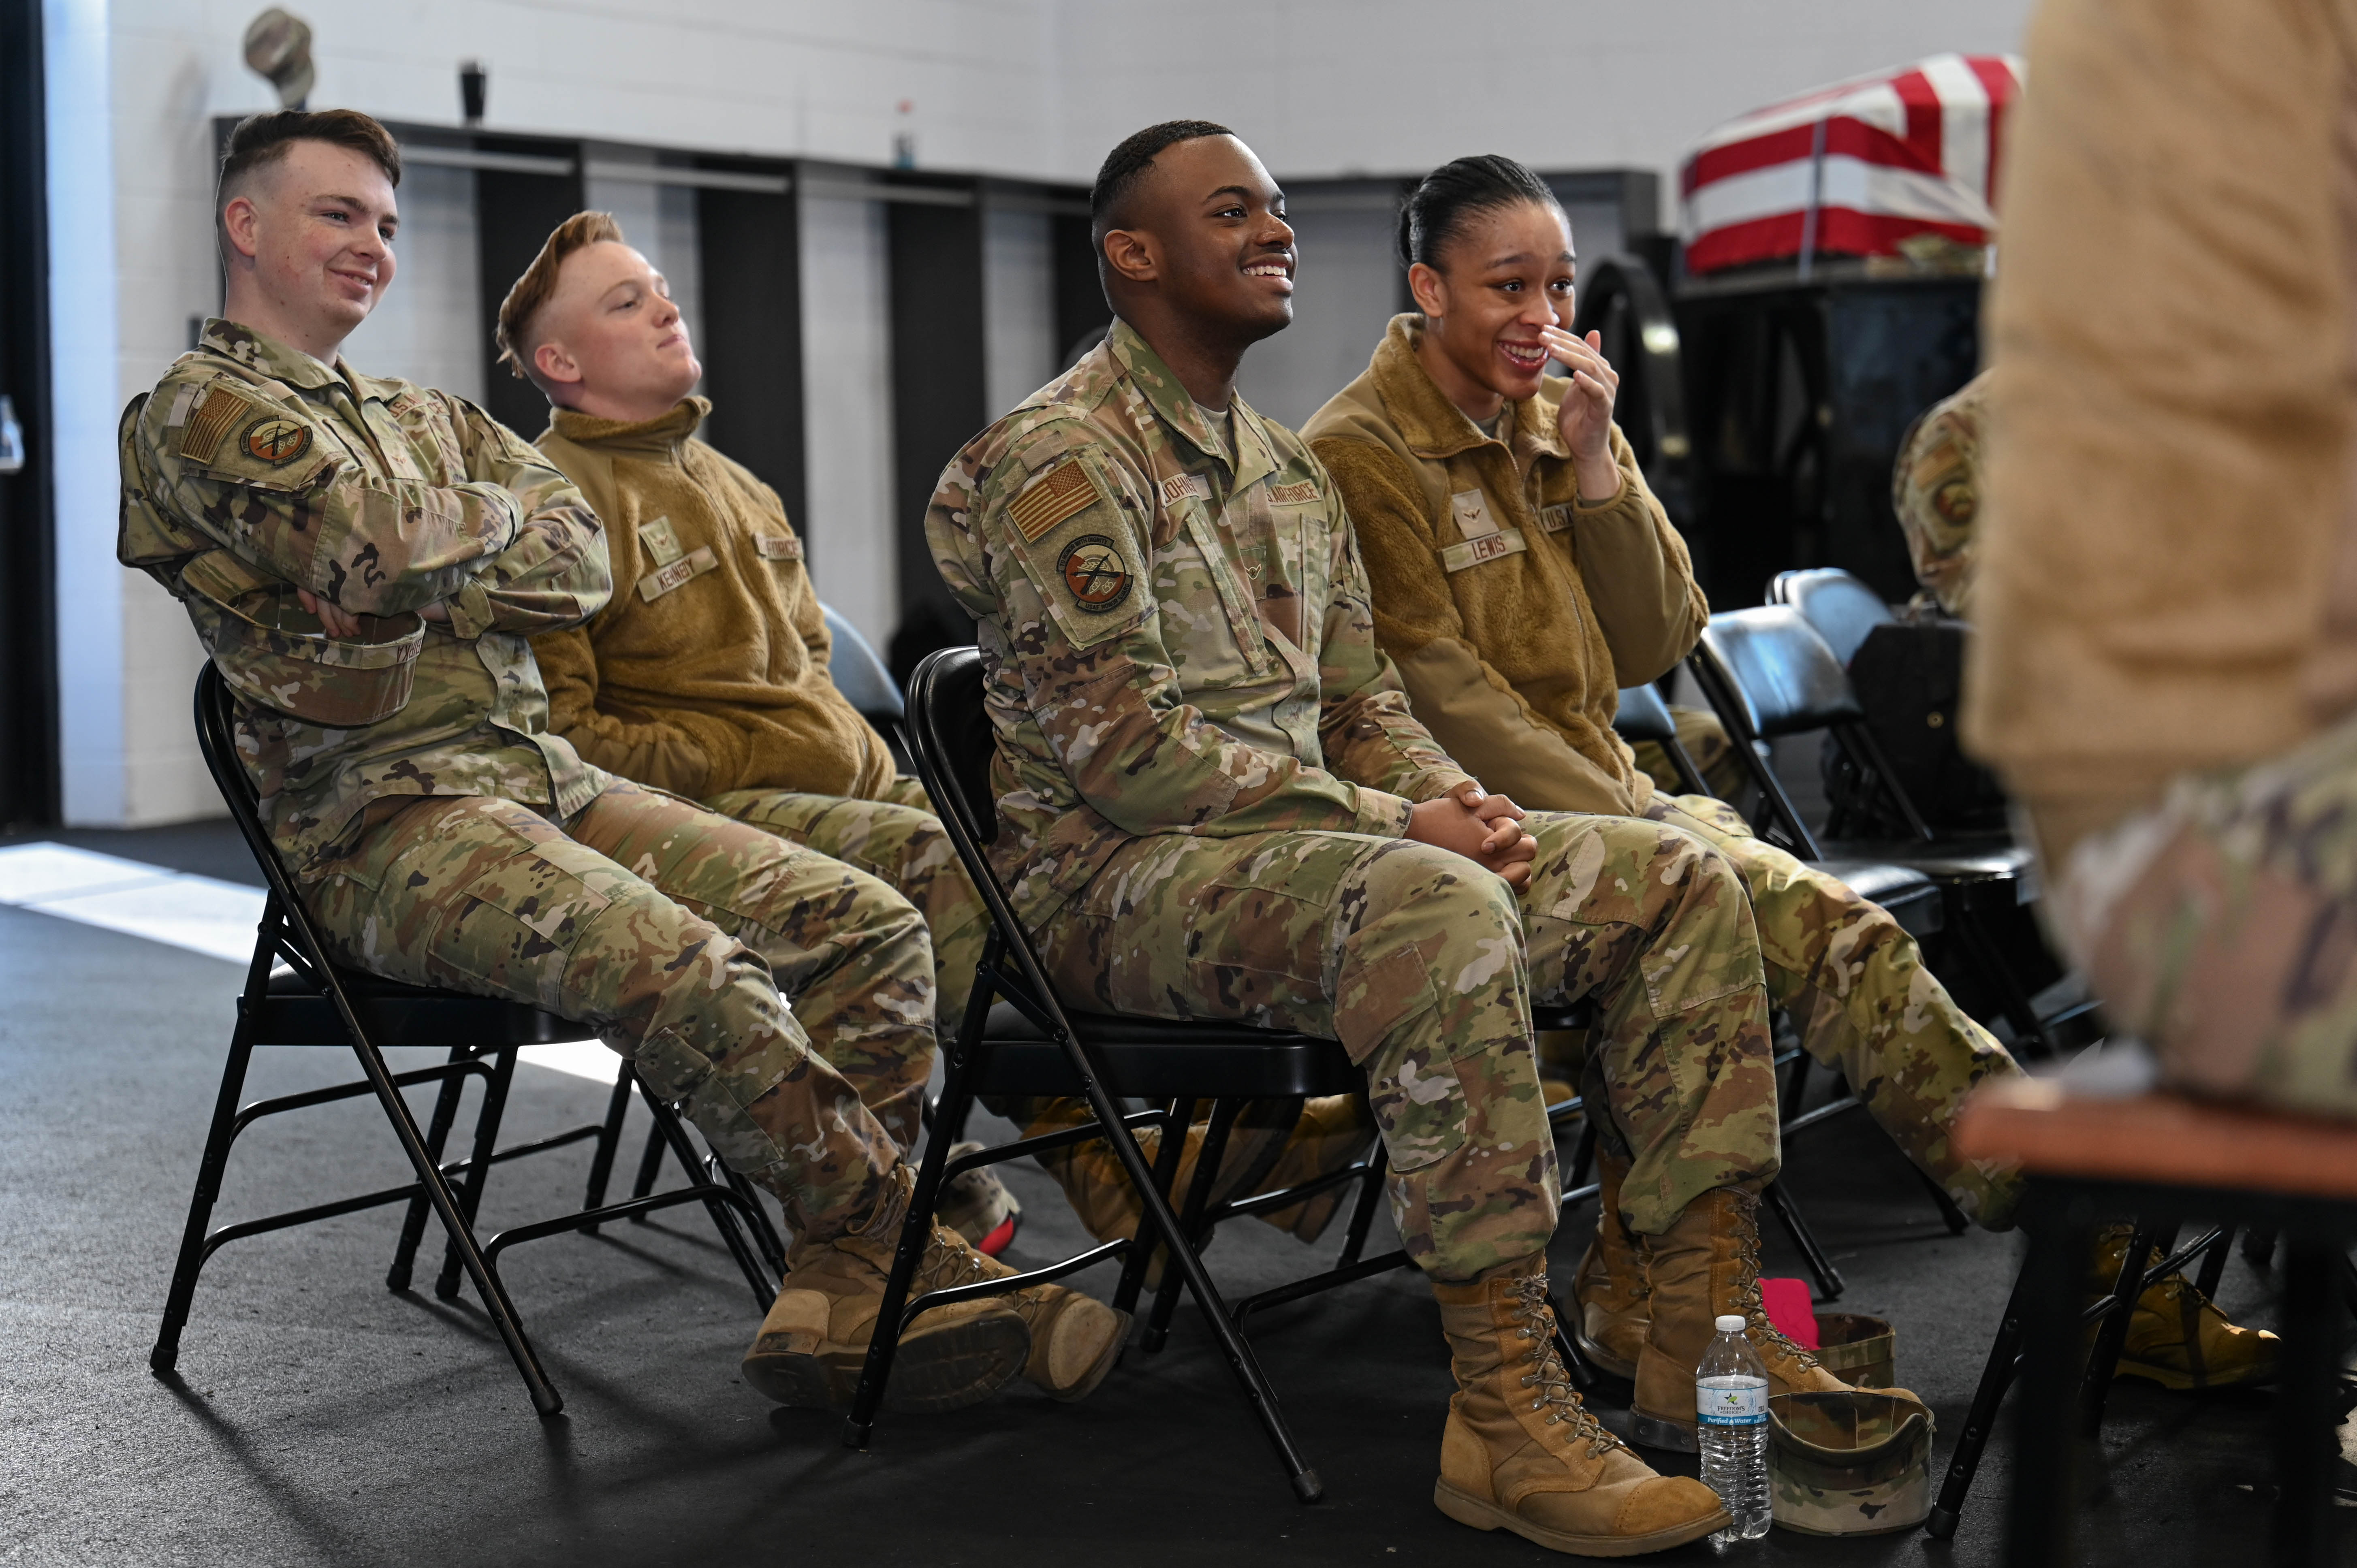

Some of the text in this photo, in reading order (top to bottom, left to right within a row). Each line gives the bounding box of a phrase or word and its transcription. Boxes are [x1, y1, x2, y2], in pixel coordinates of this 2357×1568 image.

[1270, 486, 1290, 503] AIR
[1283, 482, 1317, 502] FORCE
[1074, 538, 1087, 546] WITH
[1088, 537, 1108, 545] DIGNITY
[1471, 535, 1506, 561] LEWIS
[657, 557, 695, 591] KENNEDY
[1100, 599, 1118, 609] HONOR
[1117, 583, 1130, 599] GUARD
[397, 638, 422, 663] BIRKA
